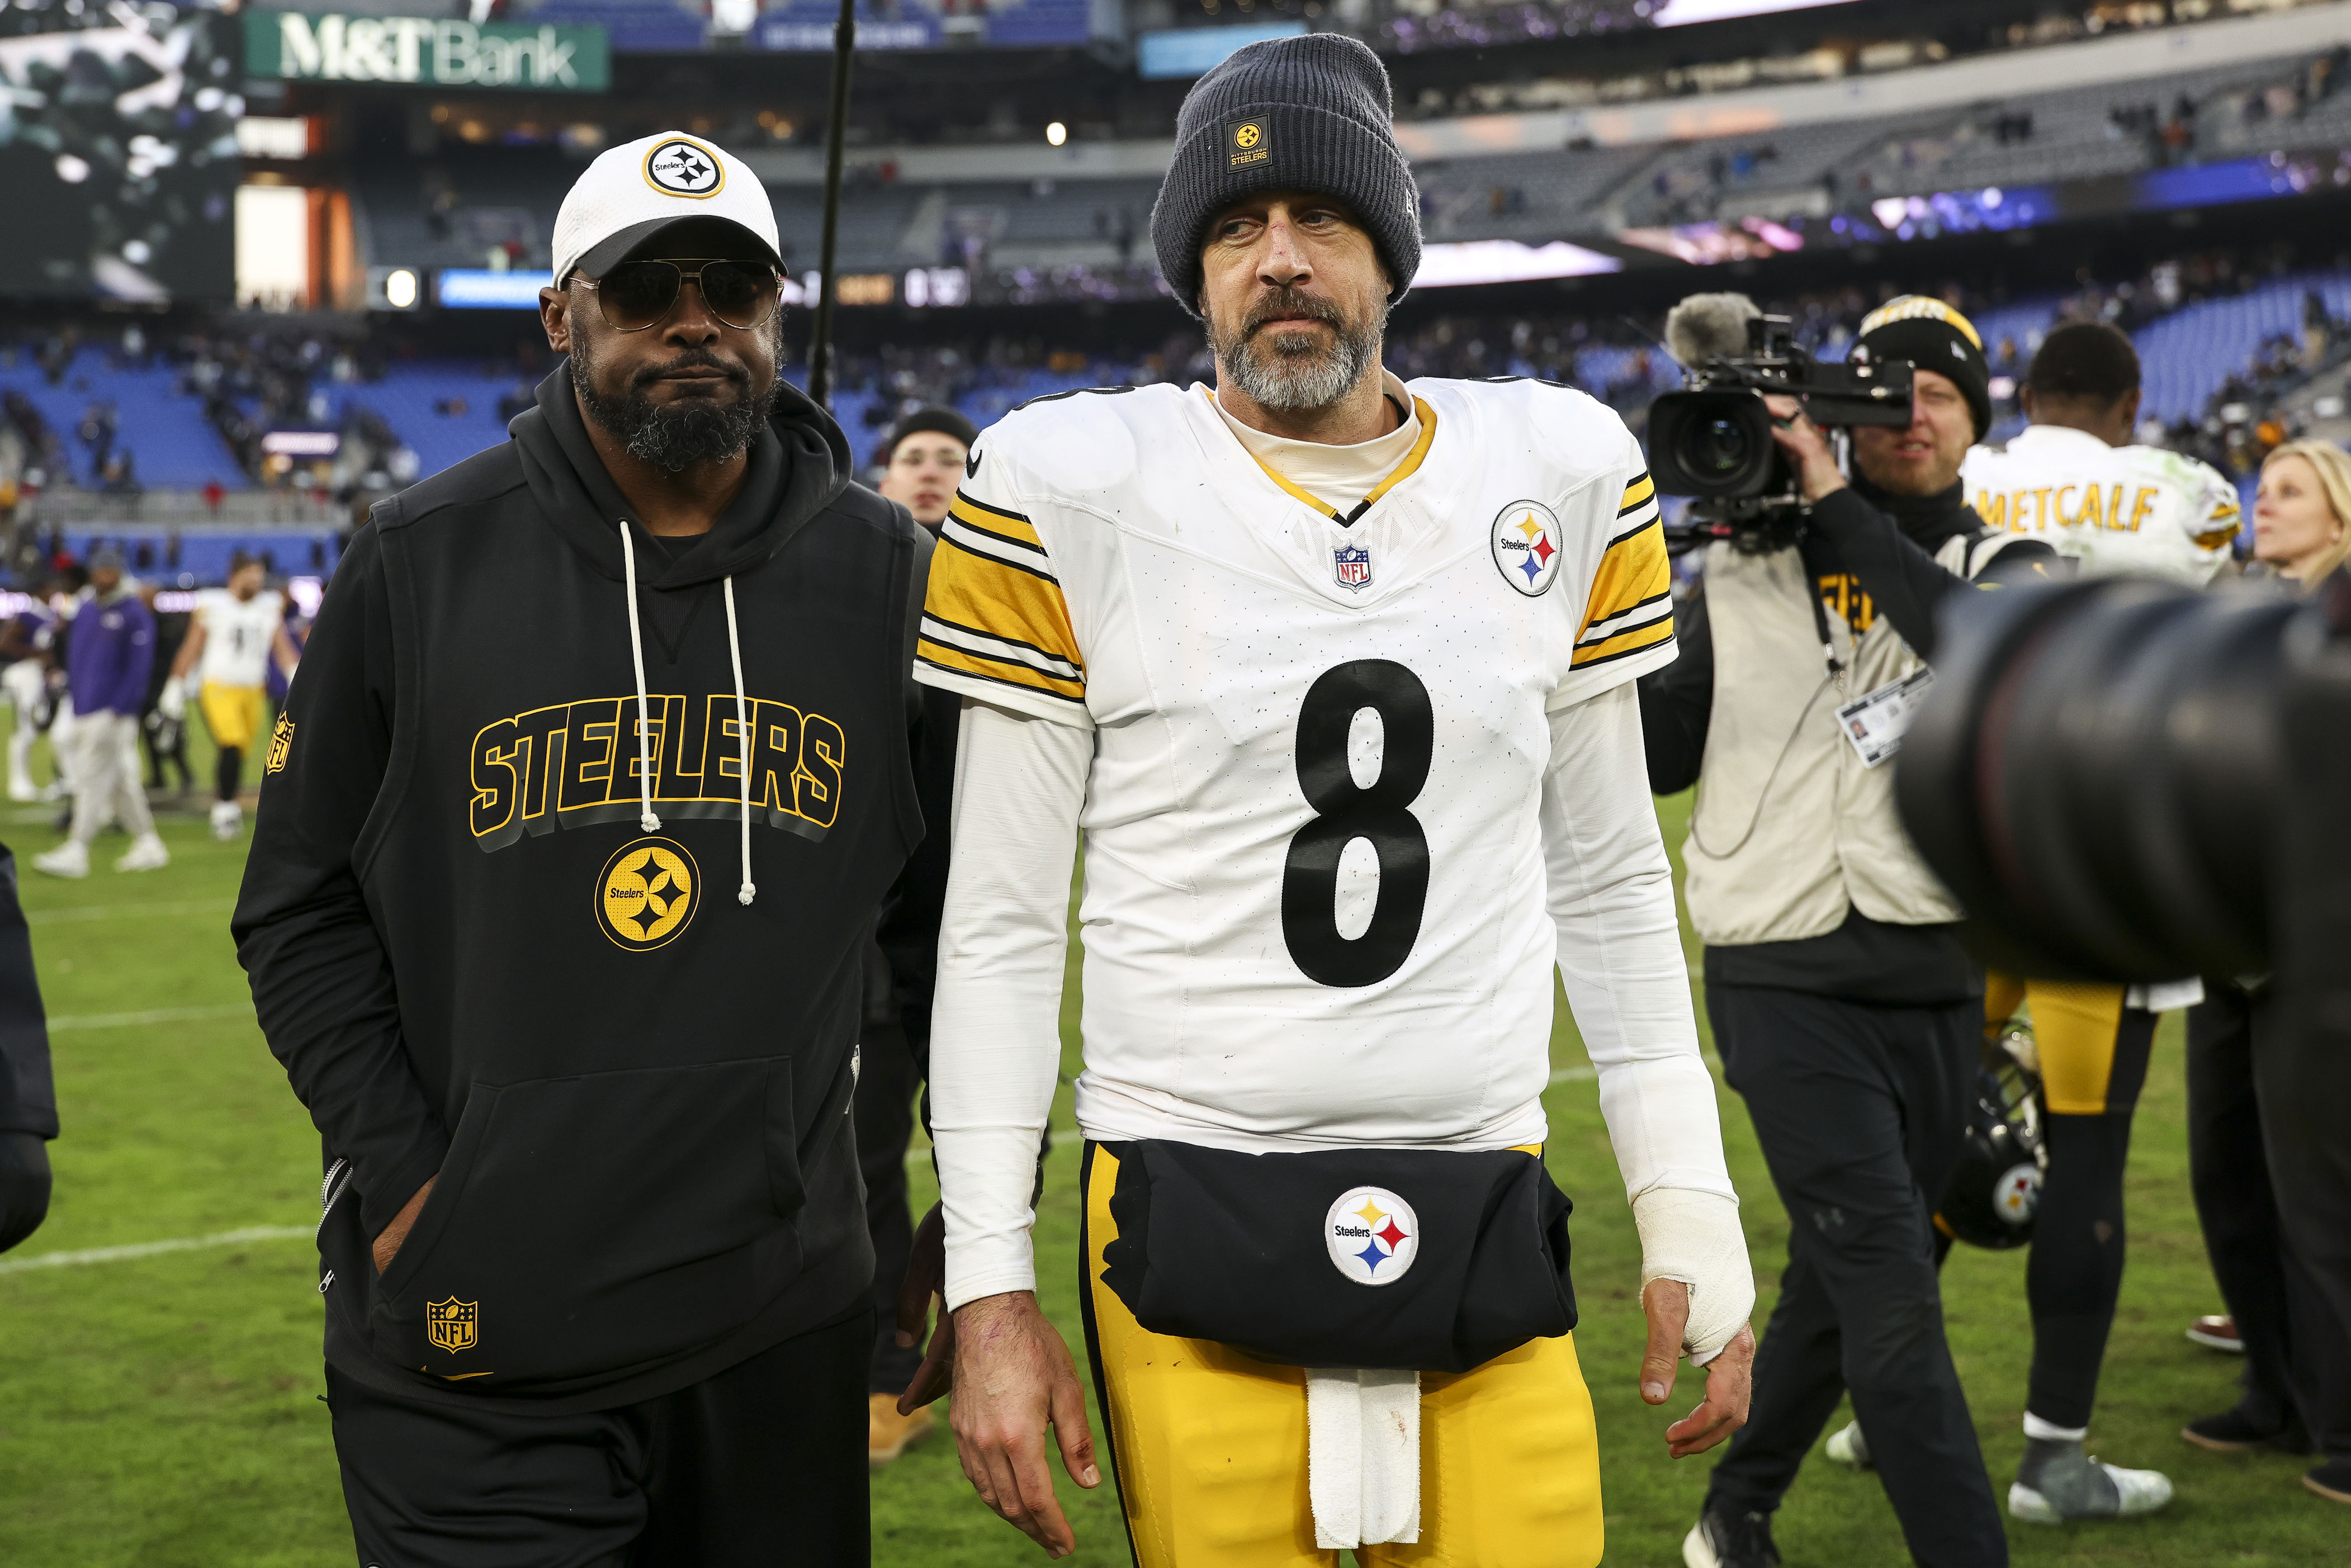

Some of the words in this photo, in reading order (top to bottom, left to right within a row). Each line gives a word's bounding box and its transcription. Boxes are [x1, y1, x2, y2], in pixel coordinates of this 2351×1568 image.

[280, 12, 434, 83] M&T
[433, 19, 579, 88] Bank
[1231, 147, 1267, 158] PITTSBURGH
[1231, 151, 1267, 165] STEELERS
[655, 162, 685, 171] Steelers
[1976, 483, 2159, 532] METCALF
[1501, 538, 1530, 552] Steelers
[1339, 563, 1368, 583] NFL
[470, 694, 845, 837] STEELERS
[1281, 659, 1434, 988] 8
[610, 887, 644, 898] Steelers
[1335, 1225, 1370, 1238] Steelers
[434, 1322, 472, 1346] NFL
